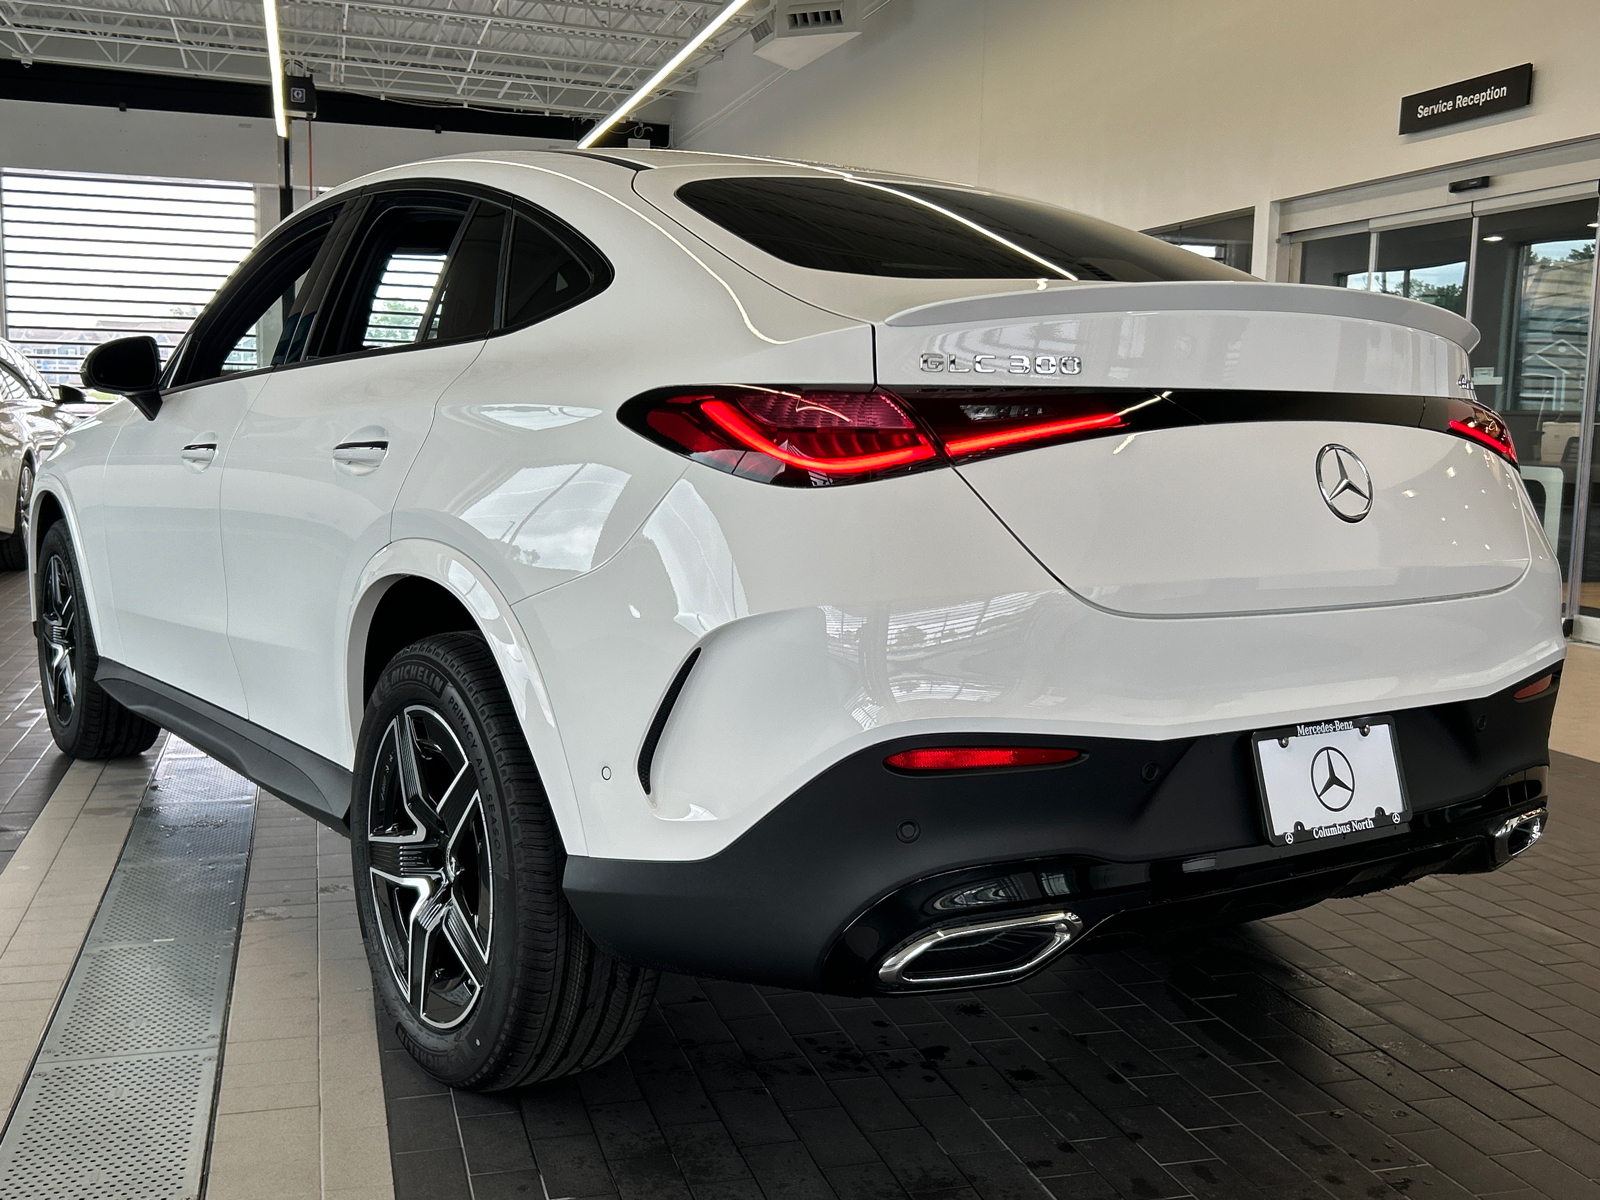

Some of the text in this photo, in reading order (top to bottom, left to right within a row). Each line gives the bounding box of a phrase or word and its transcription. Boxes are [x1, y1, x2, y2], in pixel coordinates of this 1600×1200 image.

[1417, 85, 1507, 118] Service Reception
[919, 353, 1082, 375] GLC 300
[390, 665, 444, 693] MICHELIN
[1296, 720, 1354, 736] Mercedes-Benz
[448, 696, 503, 864] PRIMACY ALL SEASON
[1313, 818, 1374, 839] Columbus North
